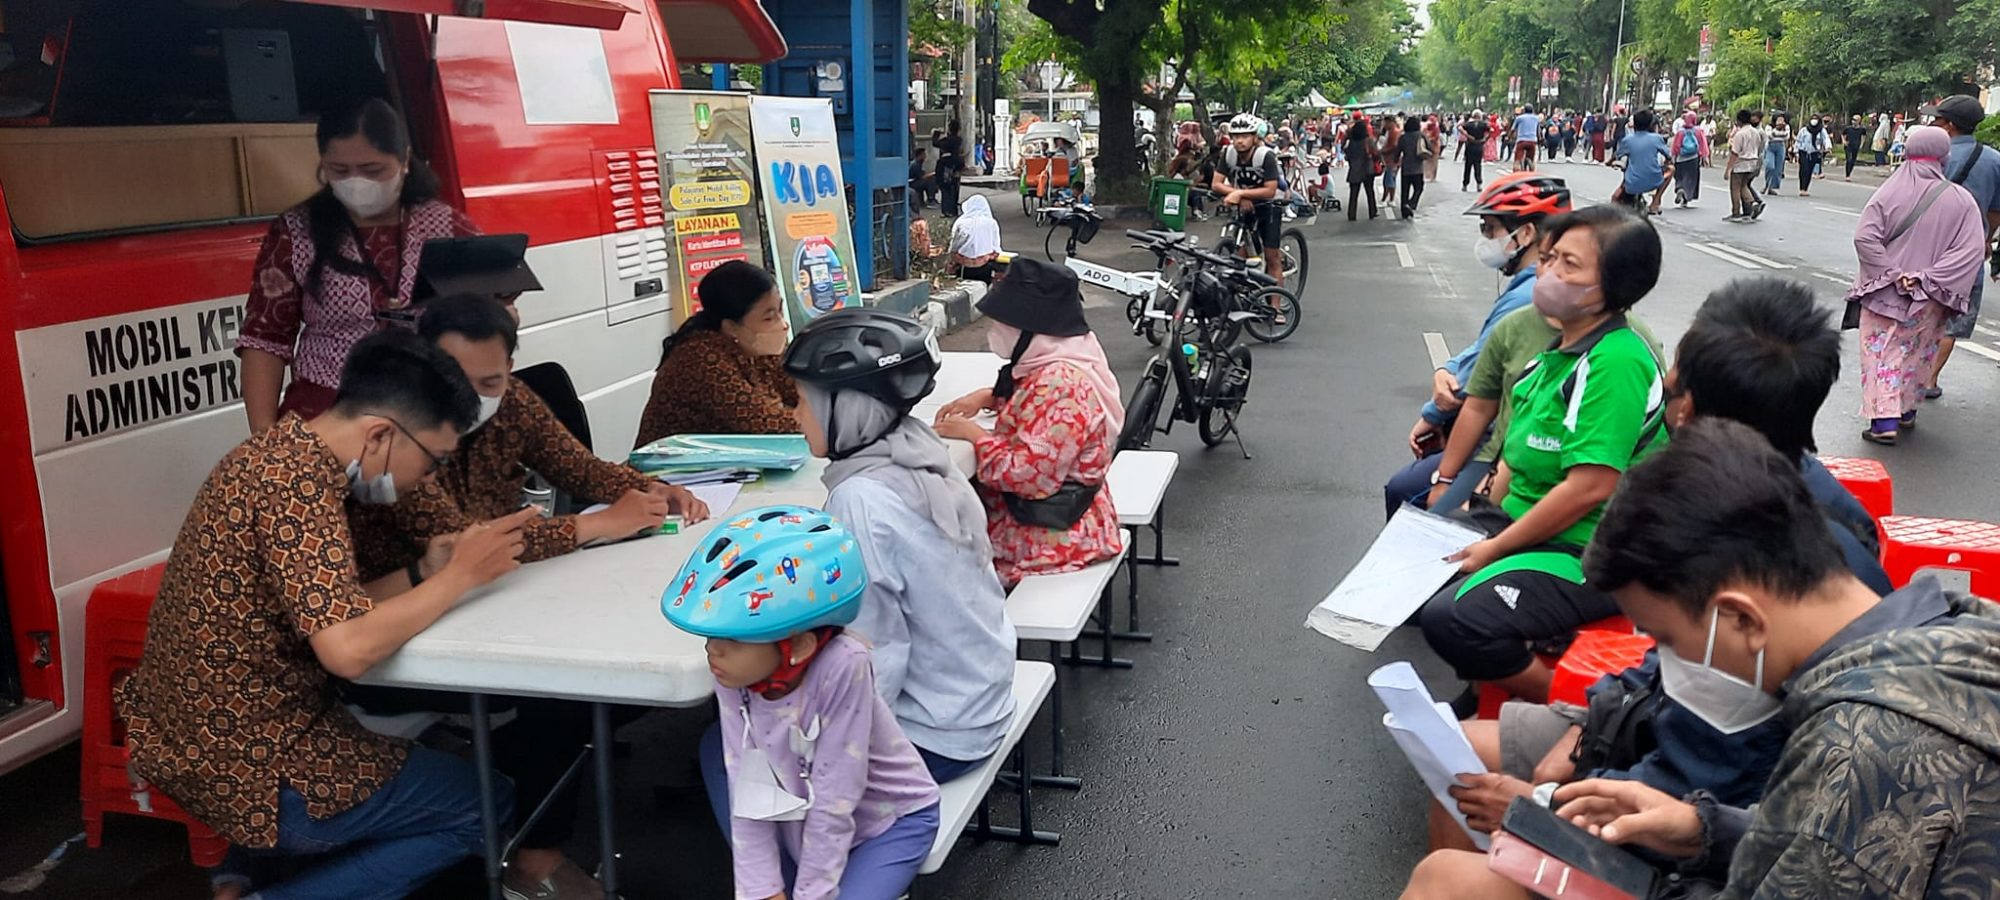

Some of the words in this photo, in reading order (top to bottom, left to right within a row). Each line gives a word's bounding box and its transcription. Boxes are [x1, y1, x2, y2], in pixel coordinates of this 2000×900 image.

[771, 161, 838, 207] KIA
[718, 194, 729, 202] Day
[677, 217, 728, 232] LAYANAN
[1083, 269, 1111, 282] ADO
[85, 316, 191, 377] MOBIL
